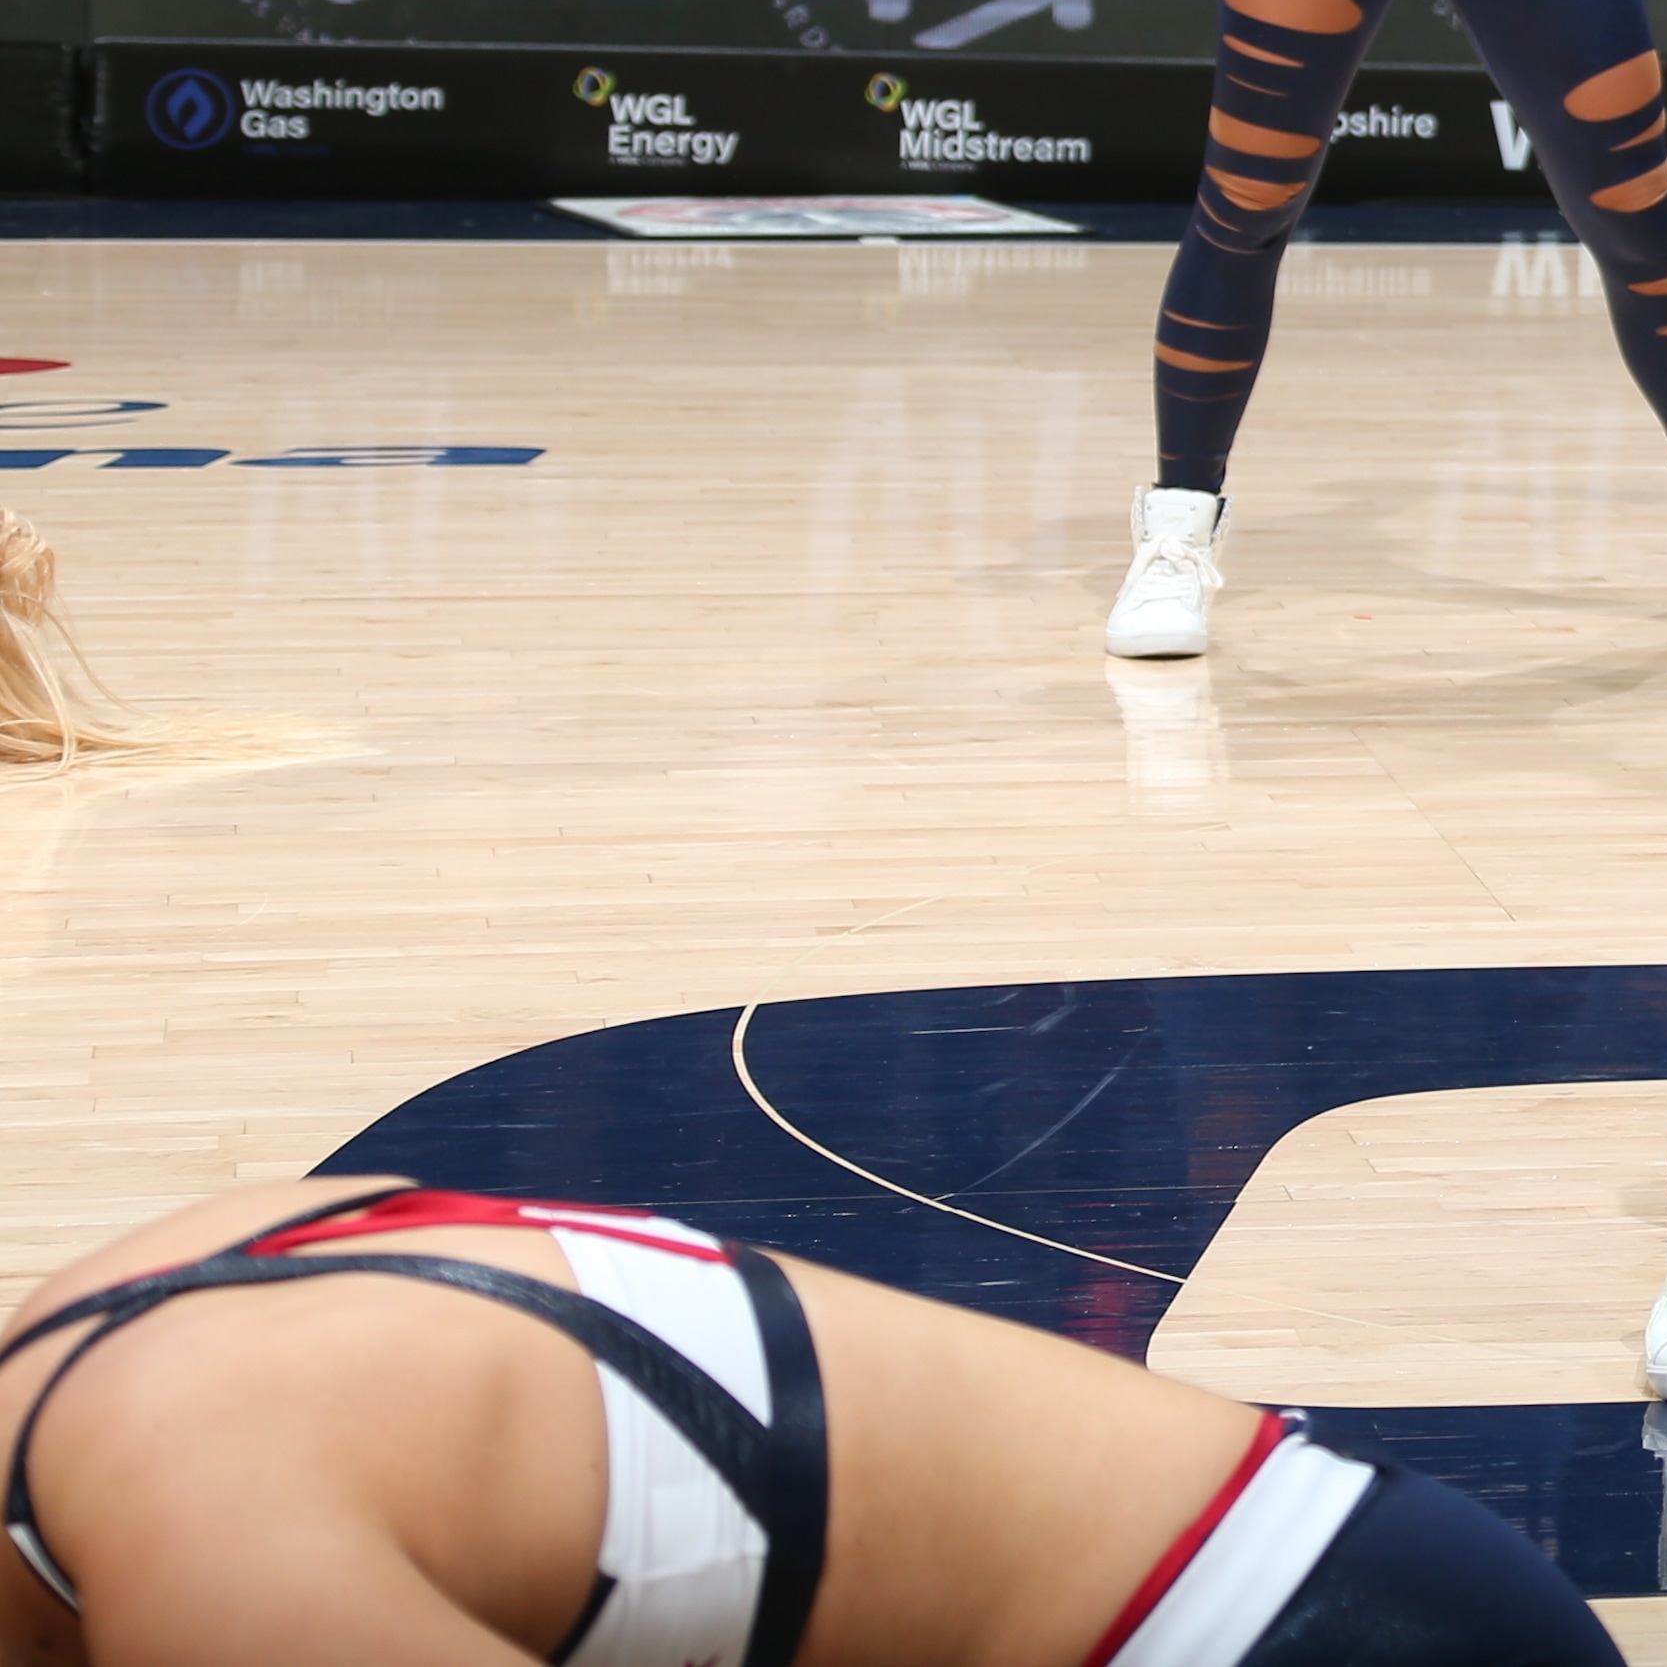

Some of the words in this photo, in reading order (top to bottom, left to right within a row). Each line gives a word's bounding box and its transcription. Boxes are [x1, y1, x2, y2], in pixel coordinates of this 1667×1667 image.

[240, 79, 445, 116] Washington
[609, 93, 697, 125] WGL
[240, 109, 309, 139] Gas
[900, 99, 985, 131] WGL
[1330, 104, 1438, 143] pshire
[608, 124, 739, 165] Energy
[899, 130, 1092, 163] Midstream
